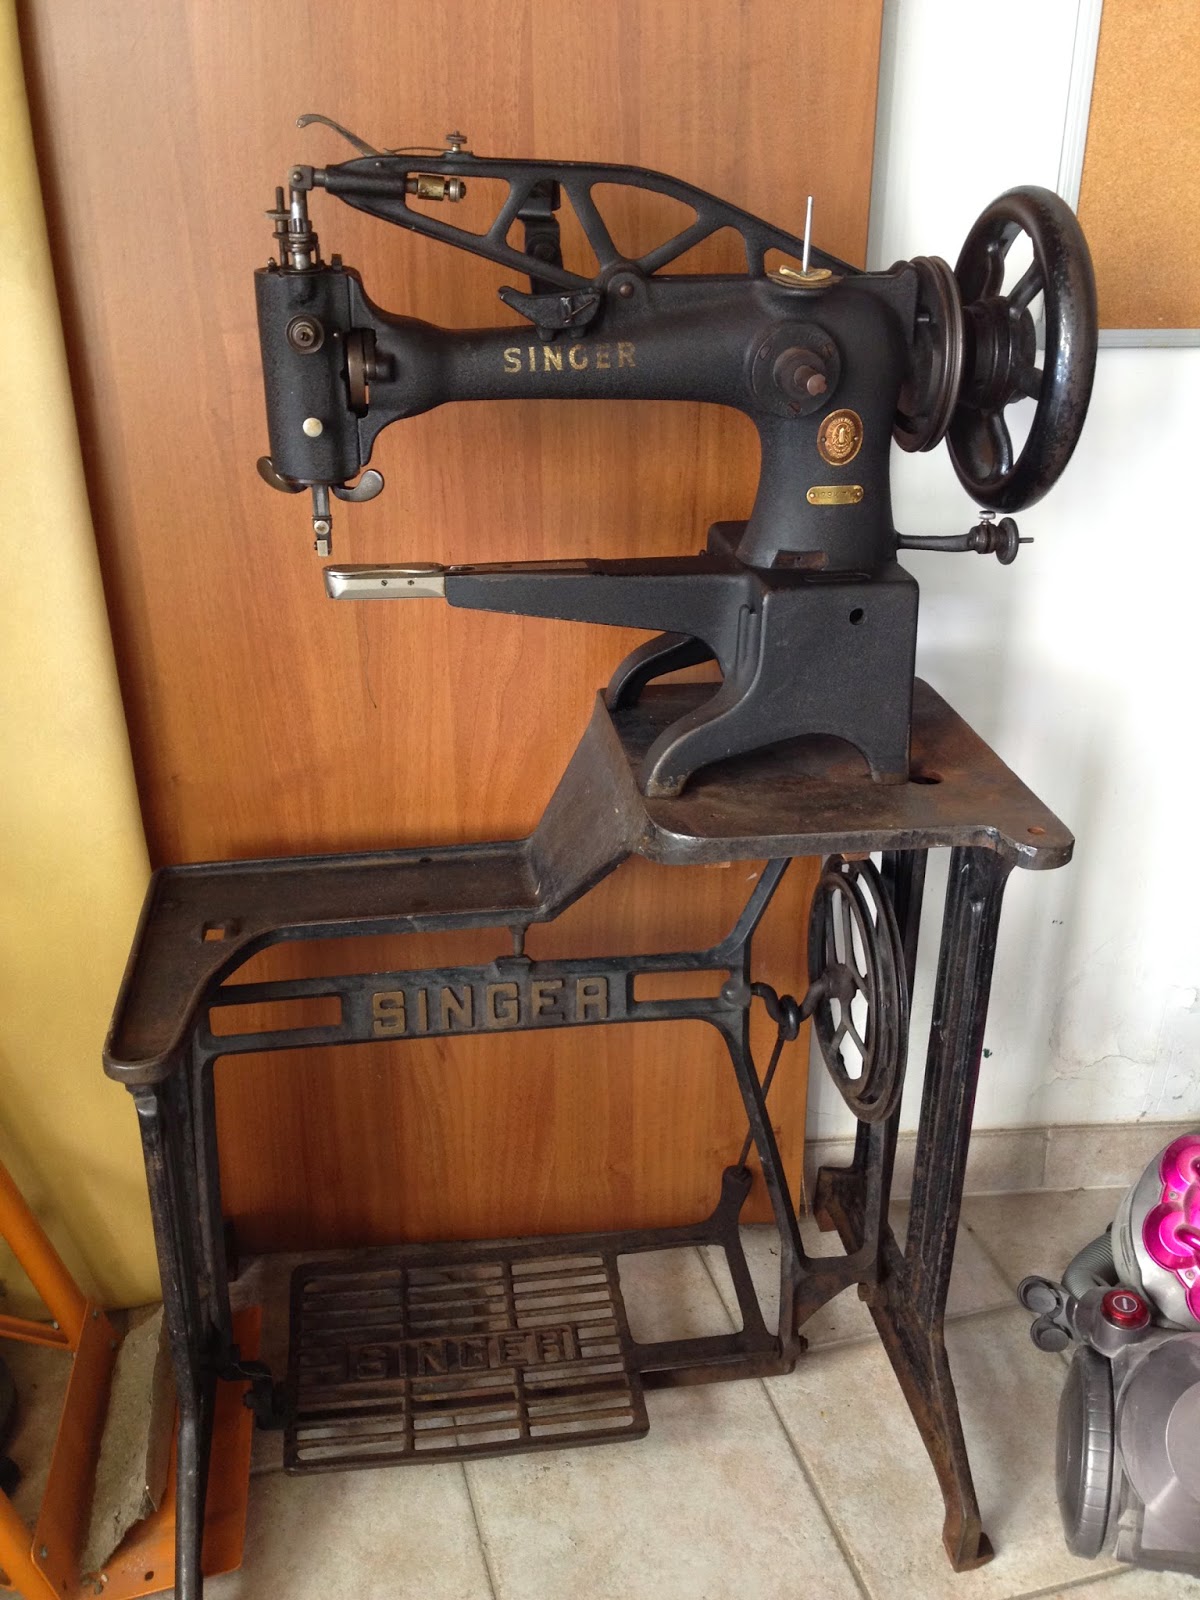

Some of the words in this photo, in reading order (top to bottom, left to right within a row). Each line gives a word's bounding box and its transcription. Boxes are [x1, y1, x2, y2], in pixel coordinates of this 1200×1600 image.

[503, 341, 636, 373] SINGER
[373, 976, 608, 1035] SINGER
[356, 1327, 577, 1379] SINGER
